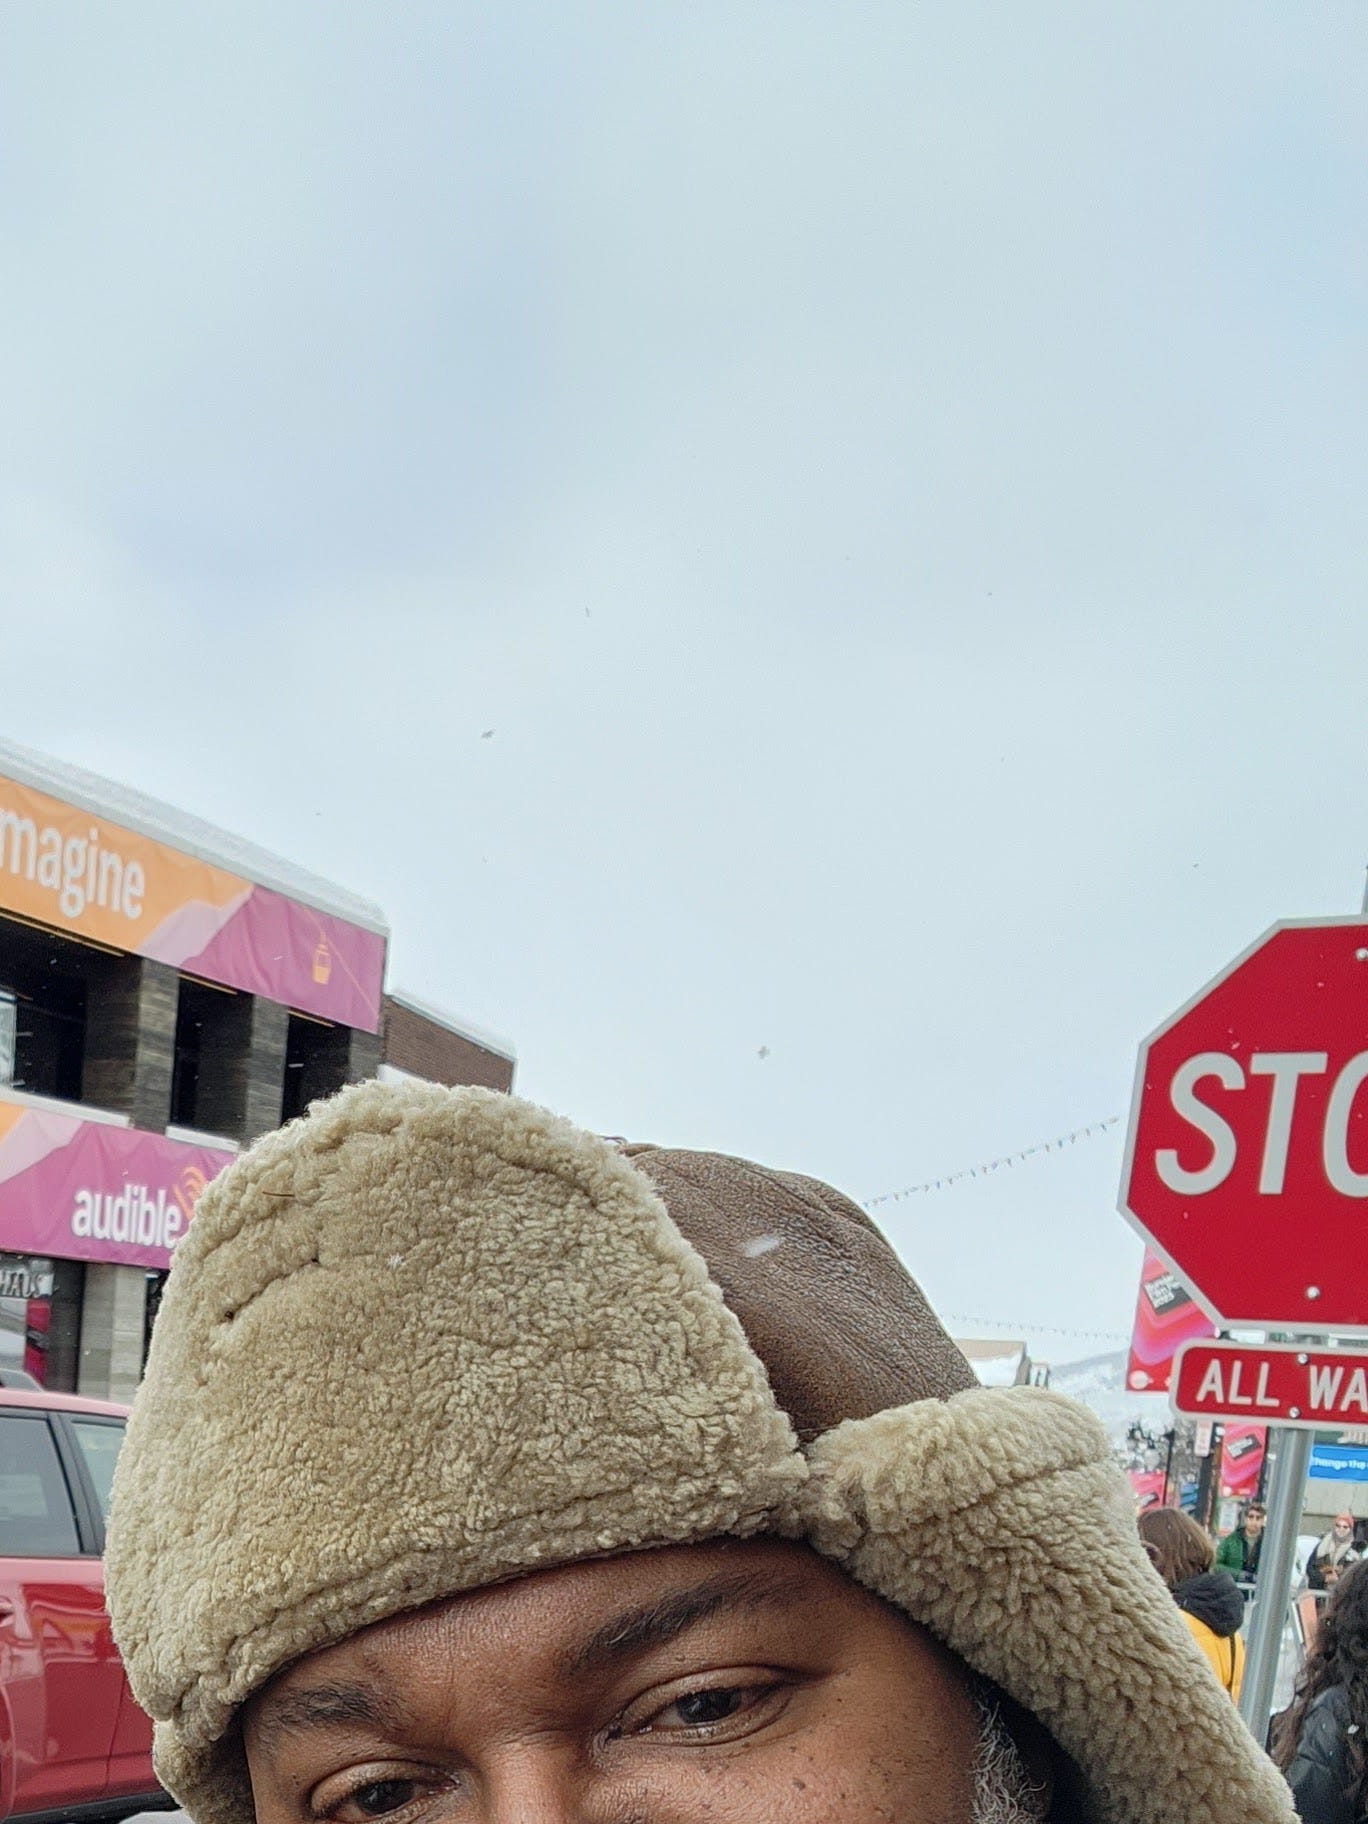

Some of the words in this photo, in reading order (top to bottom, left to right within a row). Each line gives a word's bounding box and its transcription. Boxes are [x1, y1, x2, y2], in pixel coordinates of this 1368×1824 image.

[71, 1184, 182, 1249] audible
[1196, 1358, 1280, 1407] ALL
[1309, 1365, 1368, 1414] WA
